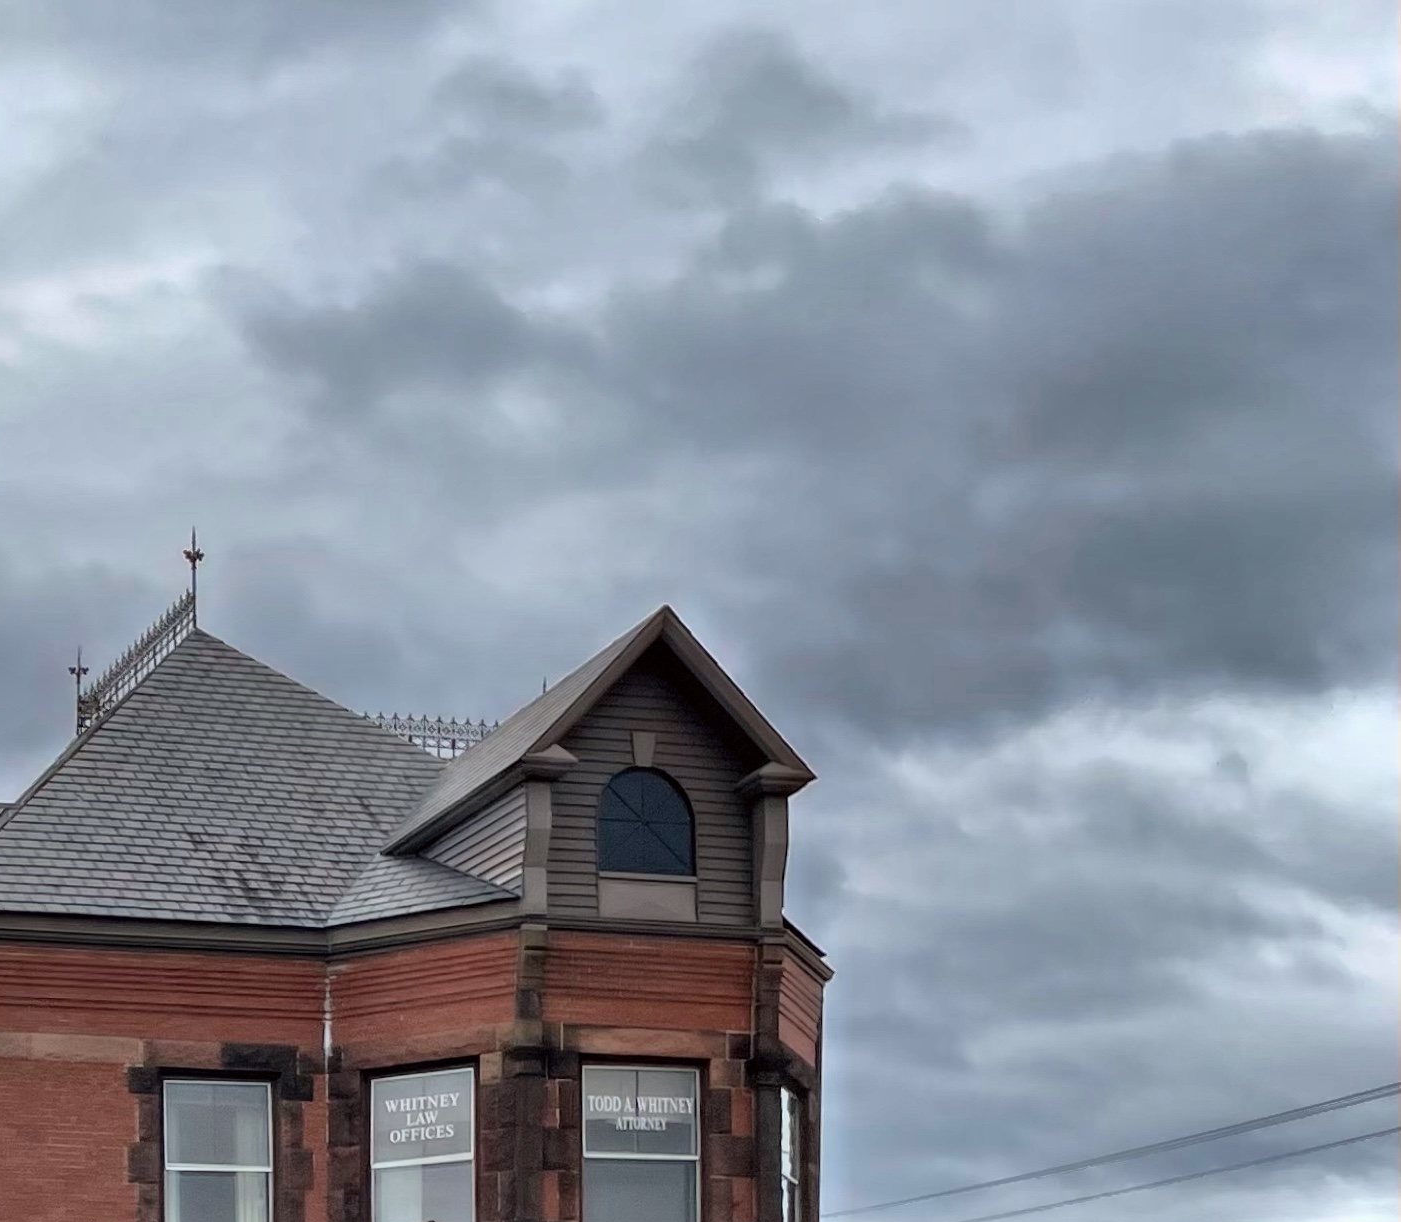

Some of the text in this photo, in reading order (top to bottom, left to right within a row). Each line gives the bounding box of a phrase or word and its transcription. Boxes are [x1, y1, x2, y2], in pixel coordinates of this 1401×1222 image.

[385, 1092, 460, 1113] WHITNEY
[587, 1095, 693, 1113] TODD A. WHITNEY
[406, 1110, 438, 1127] LAW
[615, 1116, 667, 1131] ATTORNEY
[389, 1124, 455, 1144] OFFICES
